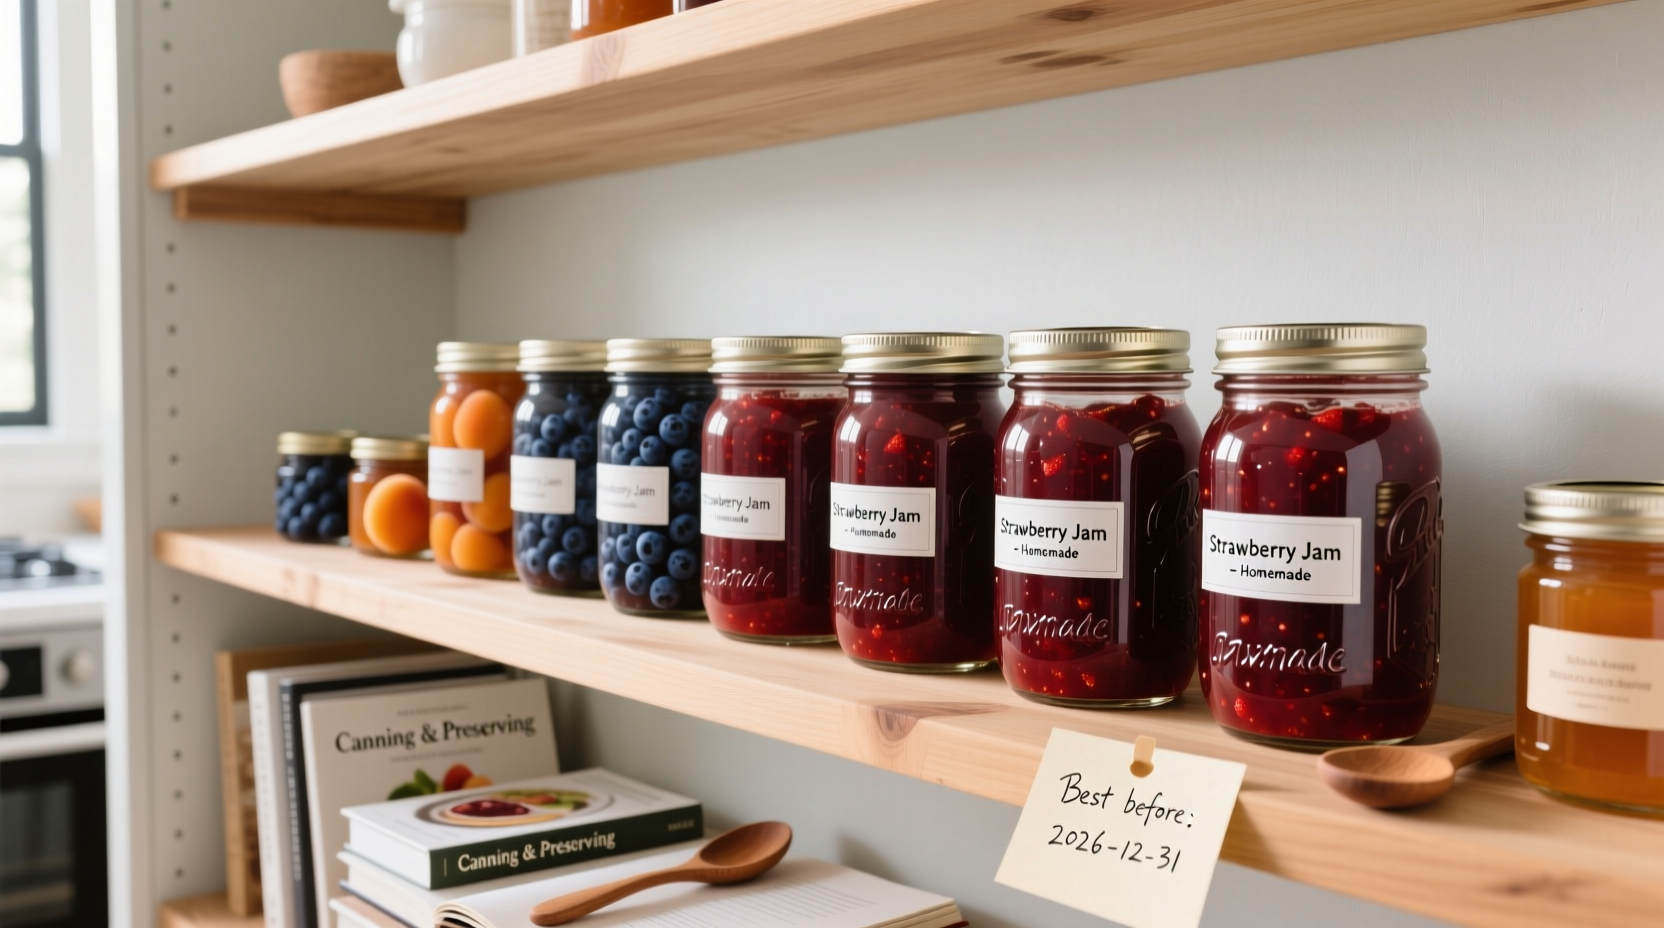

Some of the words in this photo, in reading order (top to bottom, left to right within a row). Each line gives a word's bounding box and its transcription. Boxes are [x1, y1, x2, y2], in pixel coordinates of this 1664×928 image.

[745, 496, 771, 510] Jam
[889, 507, 921, 523] Jam
[1000, 517, 1068, 543] Strawberry
[1071, 524, 1107, 541] Jam
[1209, 534, 1297, 564] Strawberry
[1301, 542, 1341, 561] Jam
[1240, 564, 1312, 581] Homemade
[335, 728, 416, 753] Canning
[421, 723, 438, 744] &
[443, 714, 536, 742] Preserving
[1060, 772, 1114, 809] Best
[1123, 788, 1194, 828] before:
[458, 849, 519, 873] Canning
[522, 844, 537, 861] &
[540, 831, 616, 858] Preserving
[1048, 825, 1181, 872] 2026-12-31
